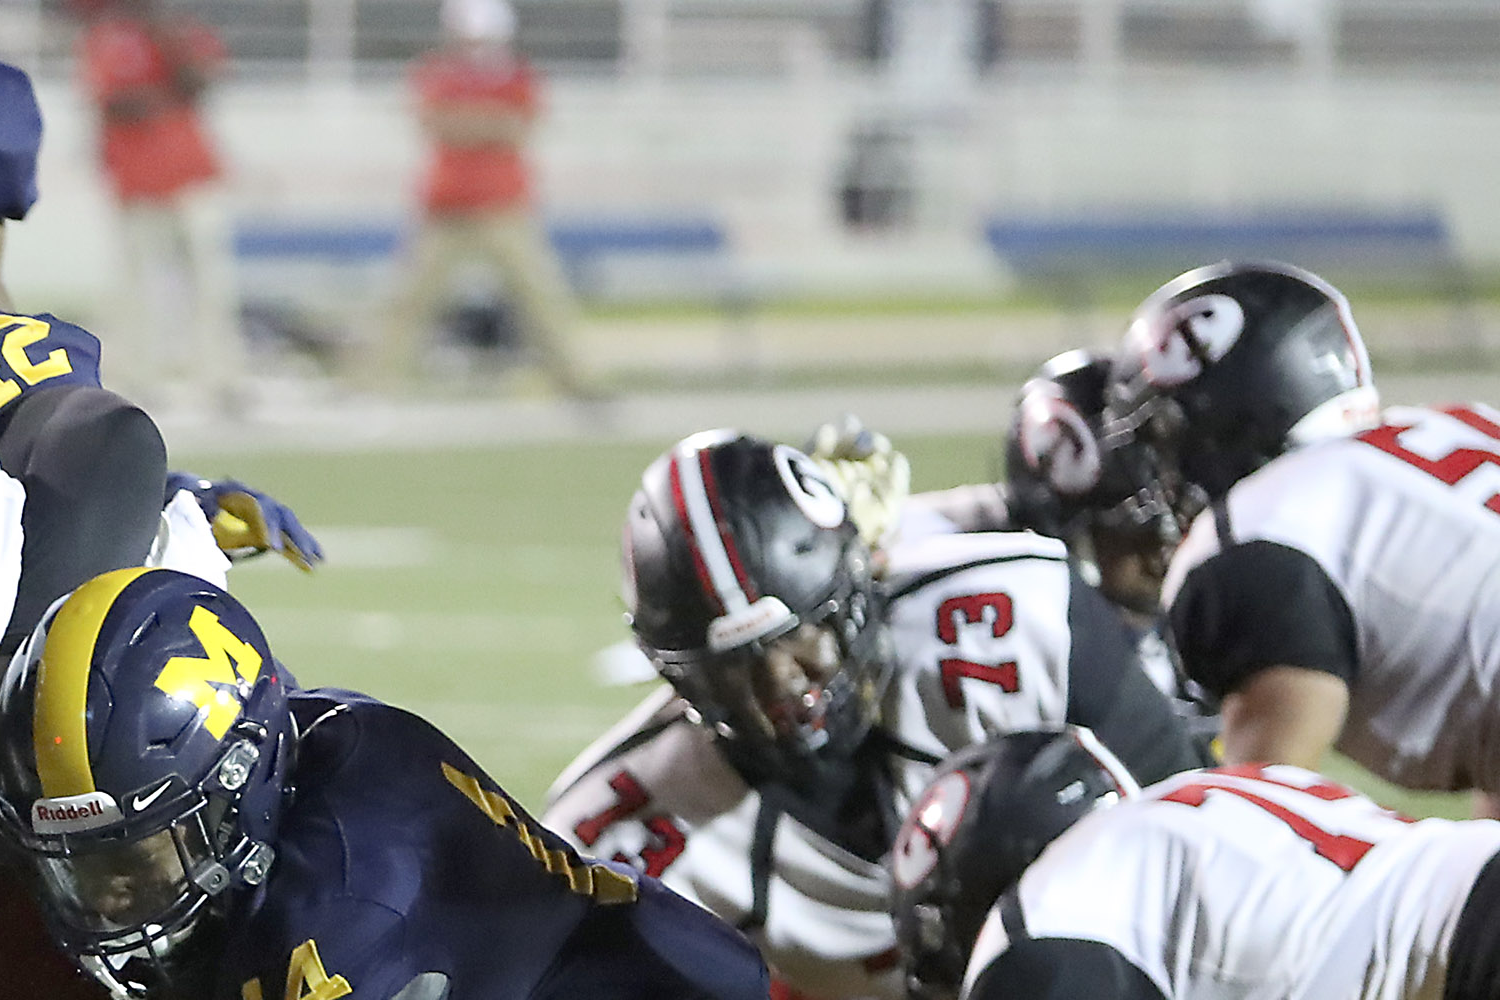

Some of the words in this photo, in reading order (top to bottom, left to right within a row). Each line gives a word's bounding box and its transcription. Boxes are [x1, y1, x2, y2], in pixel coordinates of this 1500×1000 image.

[153, 604, 263, 741] M
[937, 592, 1021, 711] 73
[36, 800, 104, 821] Riddell
